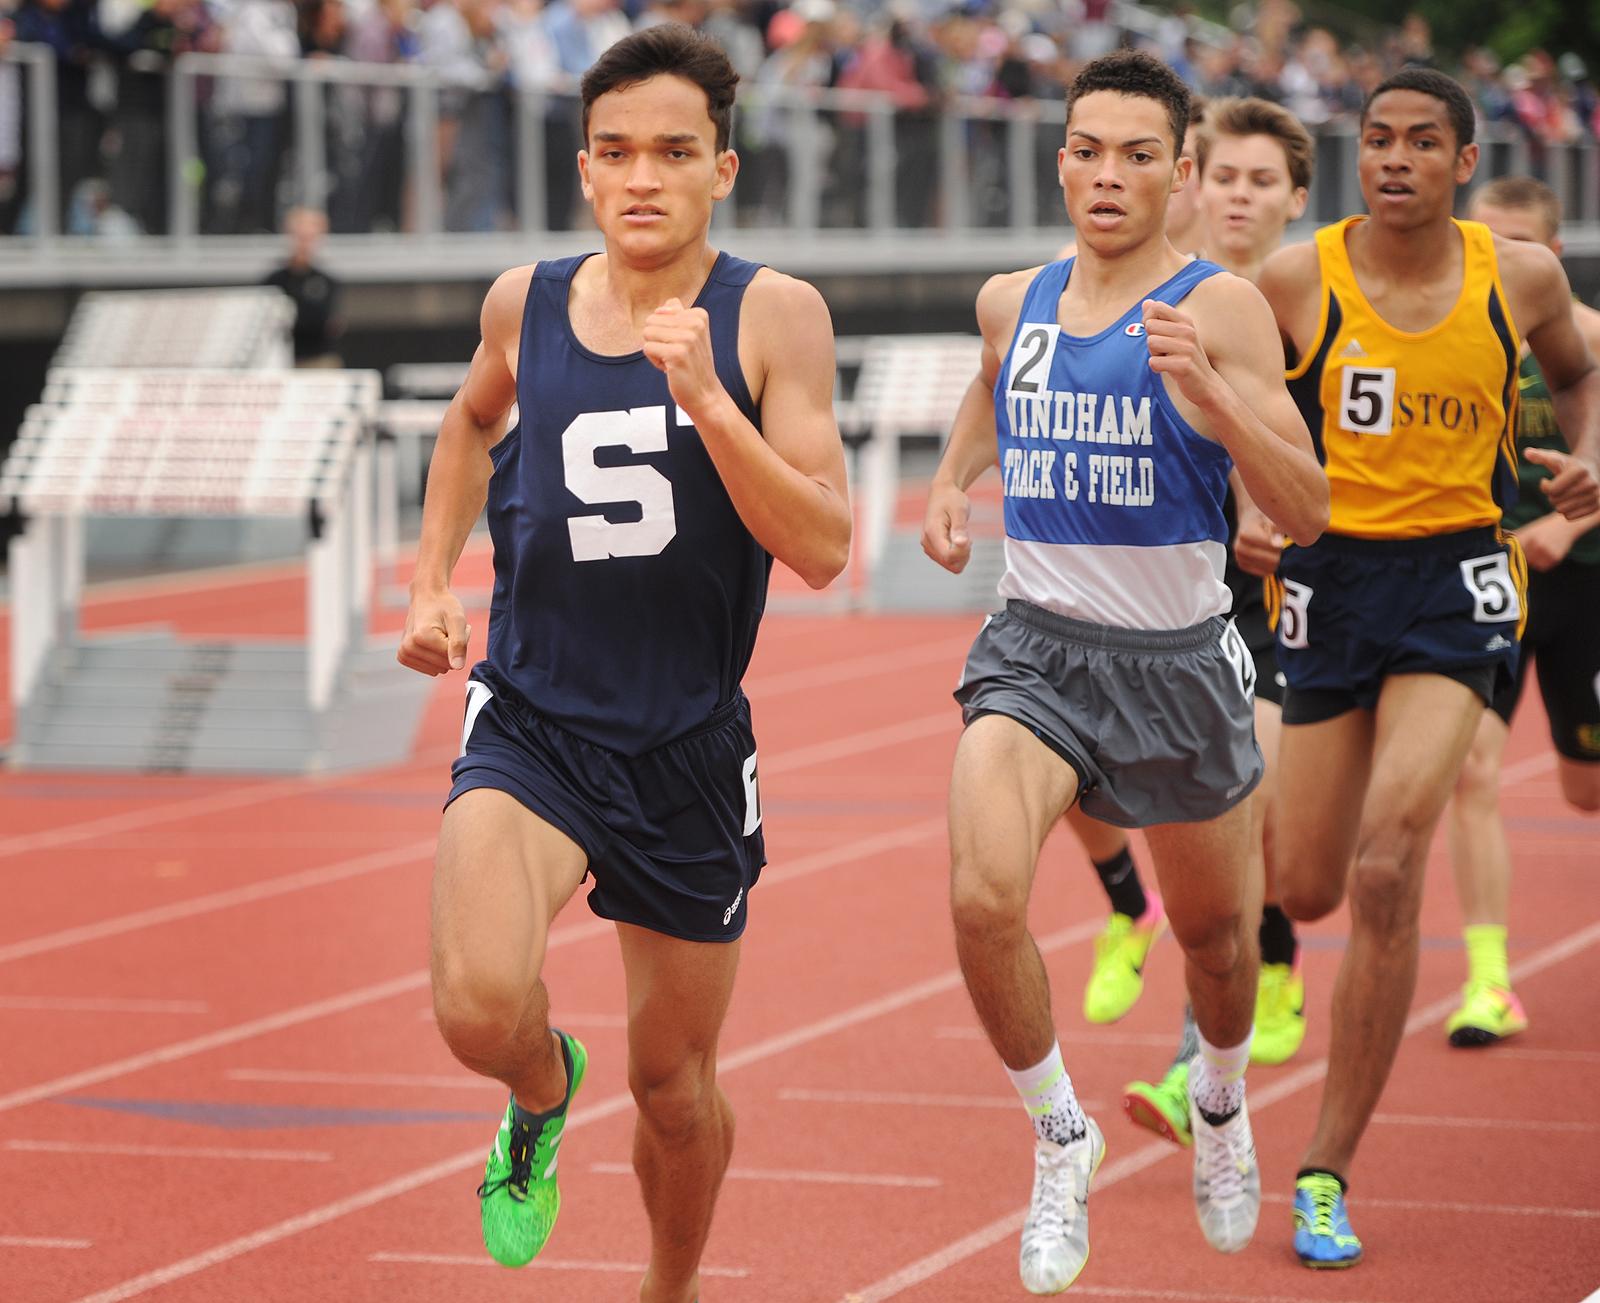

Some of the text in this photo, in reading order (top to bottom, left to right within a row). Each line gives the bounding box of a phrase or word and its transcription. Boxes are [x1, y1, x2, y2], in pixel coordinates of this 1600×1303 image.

[1011, 328, 1050, 394] 2
[1347, 371, 1385, 427] 5
[1389, 390, 1486, 436] STON
[561, 404, 695, 563] S
[1003, 448, 1155, 507] TRACK & FIELD
[1473, 561, 1509, 616] 5
